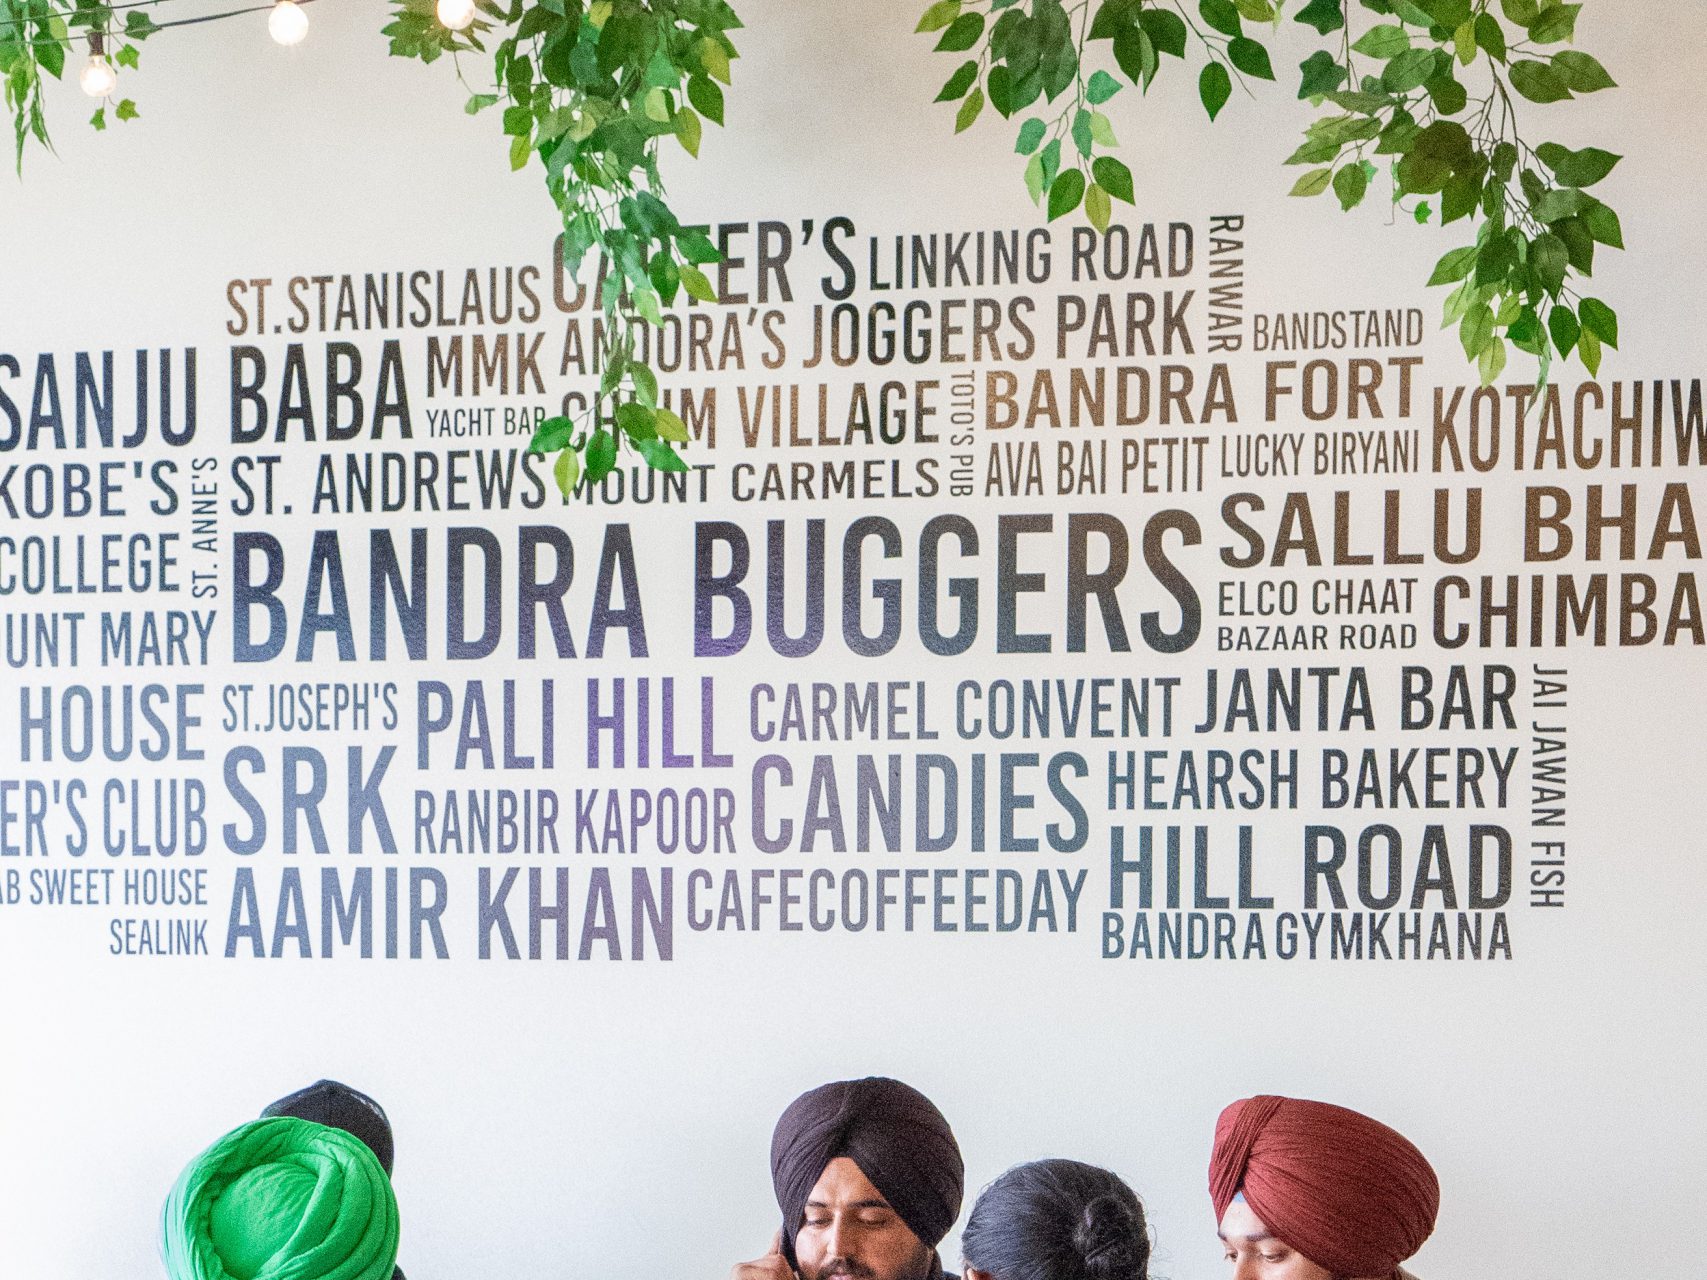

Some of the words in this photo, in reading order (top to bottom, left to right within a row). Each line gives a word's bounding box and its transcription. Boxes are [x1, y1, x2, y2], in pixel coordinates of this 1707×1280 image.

[870, 228, 1051, 291] LINKING
[1072, 222, 1193, 282] ROAD
[1208, 215, 1244, 353] RANWAR
[560, 307, 785, 376] ANDORA'S
[803, 296, 1035, 368] JOGGERS
[1057, 290, 1195, 359] PARK
[1254, 308, 1423, 351] BANDSTAND
[0, 347, 196, 452] SANJU
[231, 339, 413, 444] BABA
[427, 332, 546, 398] MMK
[986, 363, 1238, 429] BANDRA
[1265, 356, 1423, 421] FORT
[426, 408, 495, 437] YACHT
[737, 380, 939, 448] VILLAGE
[950, 370, 975, 446] TOTO'S
[231, 455, 292, 516] ST.
[312, 448, 546, 514] ANDREWS
[562, 464, 715, 506] MOUNT
[732, 458, 939, 502] CARMELS
[950, 455, 973, 497] PUB
[985, 441, 1043, 497] AVA
[1057, 440, 1106, 495] BAI
[1122, 437, 1209, 494] PETIT
[1221, 433, 1305, 477] LUCKY
[1314, 430, 1418, 475] BIRYANI
[0, 460, 178, 519] KOBE'S
[192, 457, 218, 552] ANNE'S
[1220, 488, 1482, 568] SALLU
[1524, 482, 1702, 562] BHA
[0, 533, 179, 595] COLLEGE
[192, 556, 218, 599] ST.
[233, 523, 650, 664] BANDRA
[694, 509, 1202, 659] BUGGERS
[1219, 580, 1297, 616] ELCO
[1312, 578, 1418, 615] CHAAT
[101, 610, 217, 666] MARY
[1218, 625, 1328, 651] BAZAAR
[1340, 624, 1416, 650] ROAD
[1433, 572, 1705, 649] CHIMBA
[751, 681, 938, 742] CARMEL
[957, 677, 1181, 740] CONVENT
[1195, 667, 1375, 733] JANTA
[1401, 664, 1517, 730] BAR
[1533, 663, 1567, 707] JAI
[21, 684, 204, 762] HOUSE
[418, 679, 554, 770] PALI
[587, 677, 733, 769] HILL
[223, 746, 398, 855] SRK
[752, 751, 1089, 854] CANDIES
[1108, 749, 1298, 810] HEARSH
[1322, 747, 1519, 809] BAKERY
[1532, 721, 1566, 826] JAWAN
[0, 779, 87, 857] ER'S
[104, 778, 207, 857] CLUB
[415, 789, 559, 853] RANBIR
[576, 788, 736, 854] KAPOOR
[30, 869, 114, 905] SWEET
[125, 869, 207, 905] HOUSE
[1110, 825, 1274, 909] HILL
[1304, 824, 1512, 910] ROAD
[1530, 842, 1565, 907] FISH
[110, 919, 208, 955] SEALINK
[225, 867, 449, 959] AAMIR
[479, 867, 673, 961] KHAN
